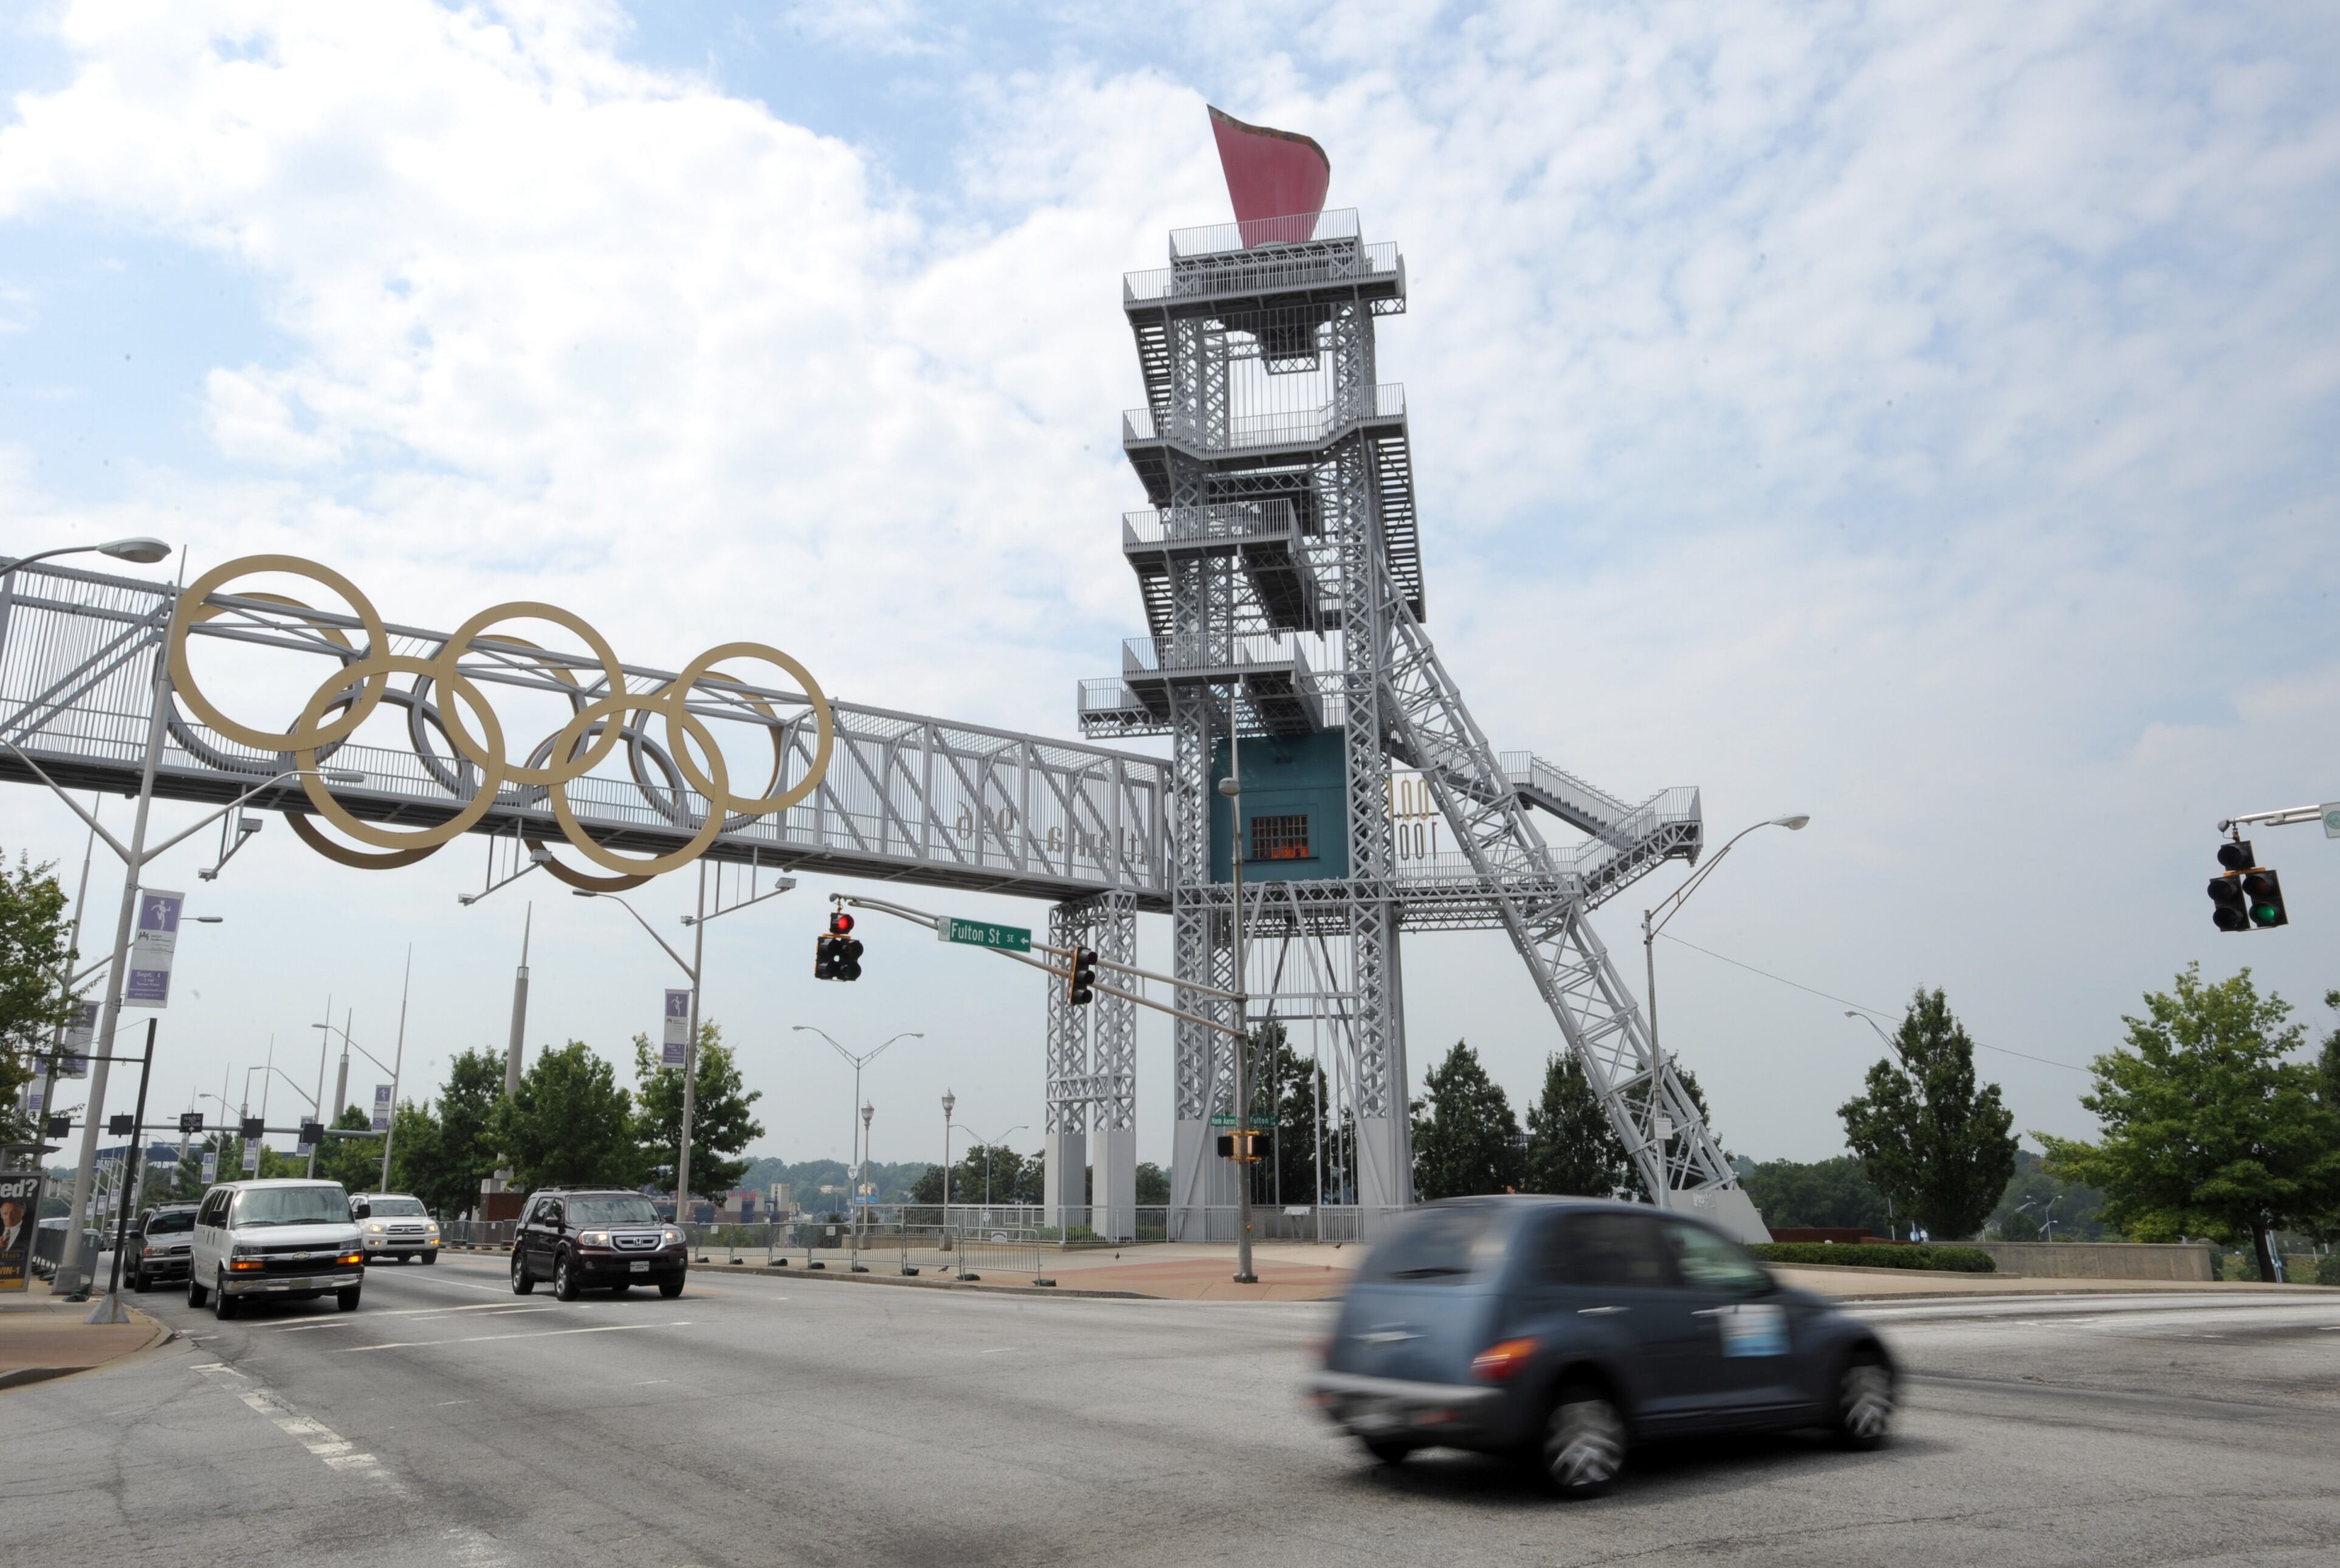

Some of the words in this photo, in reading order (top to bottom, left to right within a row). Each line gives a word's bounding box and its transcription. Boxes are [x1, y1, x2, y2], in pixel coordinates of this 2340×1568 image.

[1385, 779, 1430, 822] 100
[951, 922, 984, 942] Fulton
[988, 927, 1000, 944] St
[1007, 934, 1014, 943] SE
[0, 1179, 38, 1197] ed?
